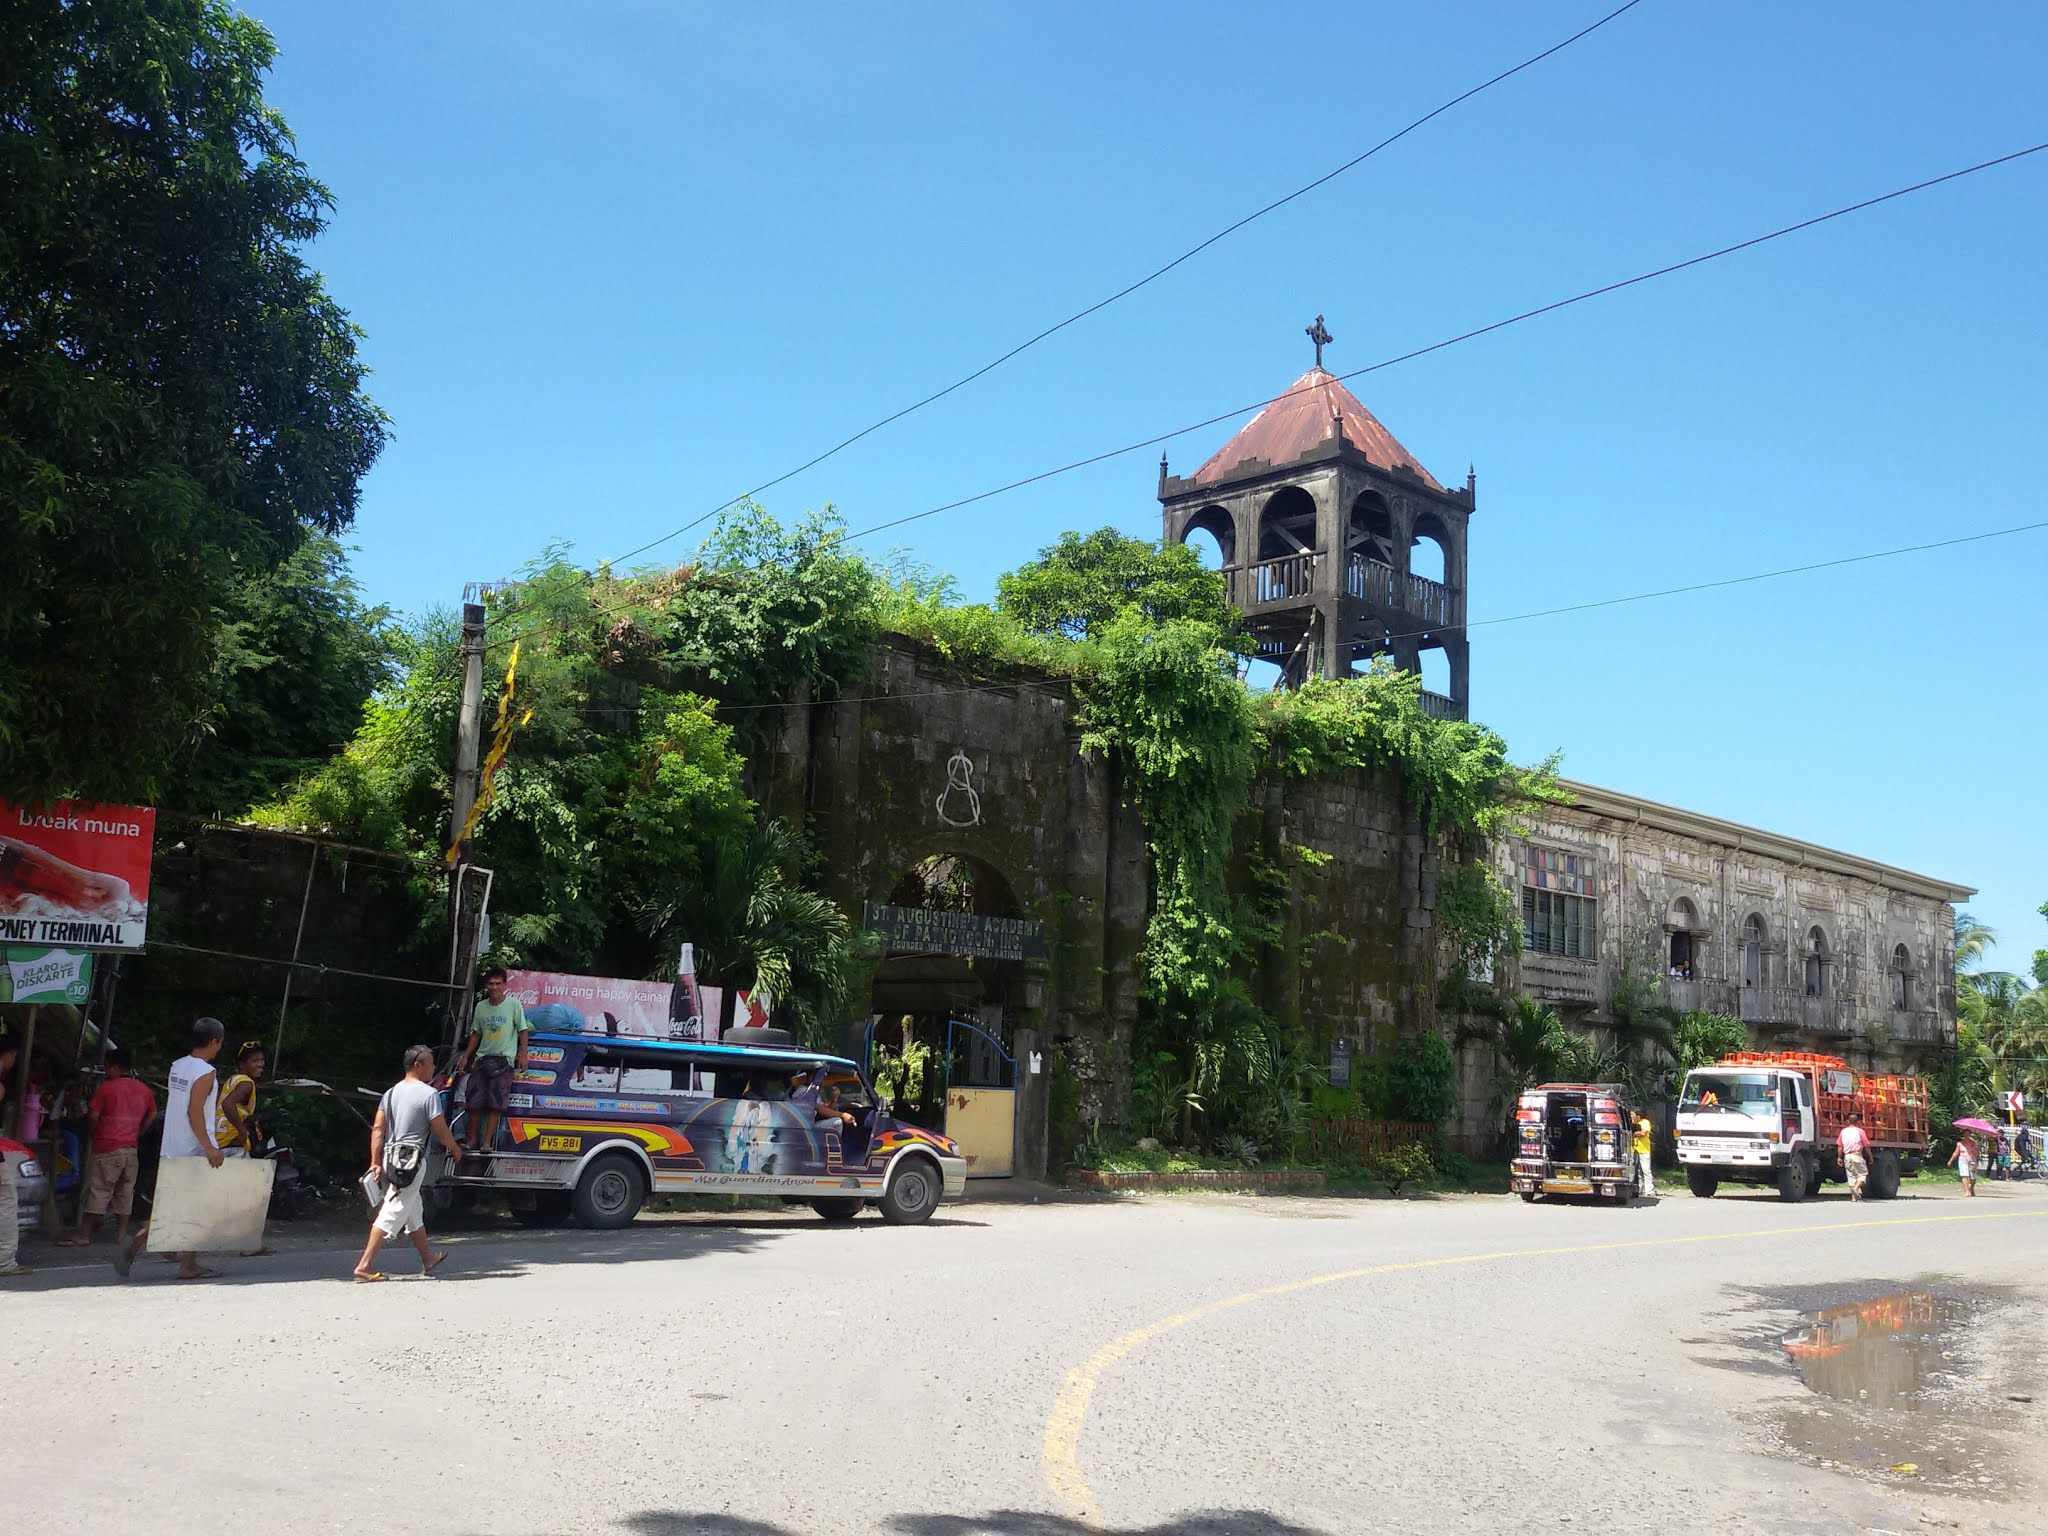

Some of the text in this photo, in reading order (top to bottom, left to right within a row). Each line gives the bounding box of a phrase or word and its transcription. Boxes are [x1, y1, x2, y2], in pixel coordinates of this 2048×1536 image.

[19, 809, 140, 837] break muna
[872, 904, 890, 921] ST.
[897, 906, 979, 931] AUGUSTINE'S
[40, 921, 124, 944] TERMINAL
[893, 923, 909, 940] OF
[1000, 933, 1023, 951] INC.
[892, 940, 924, 951] FOUNDED
[995, 948, 1023, 960] ANTIQUE
[16, 967, 74, 990] DISKARTE
[23, 962, 59, 979] KLARO
[544, 982, 669, 1004] iuwi ang happy kainan
[694, 1175, 816, 1186] My Guardian Angel
